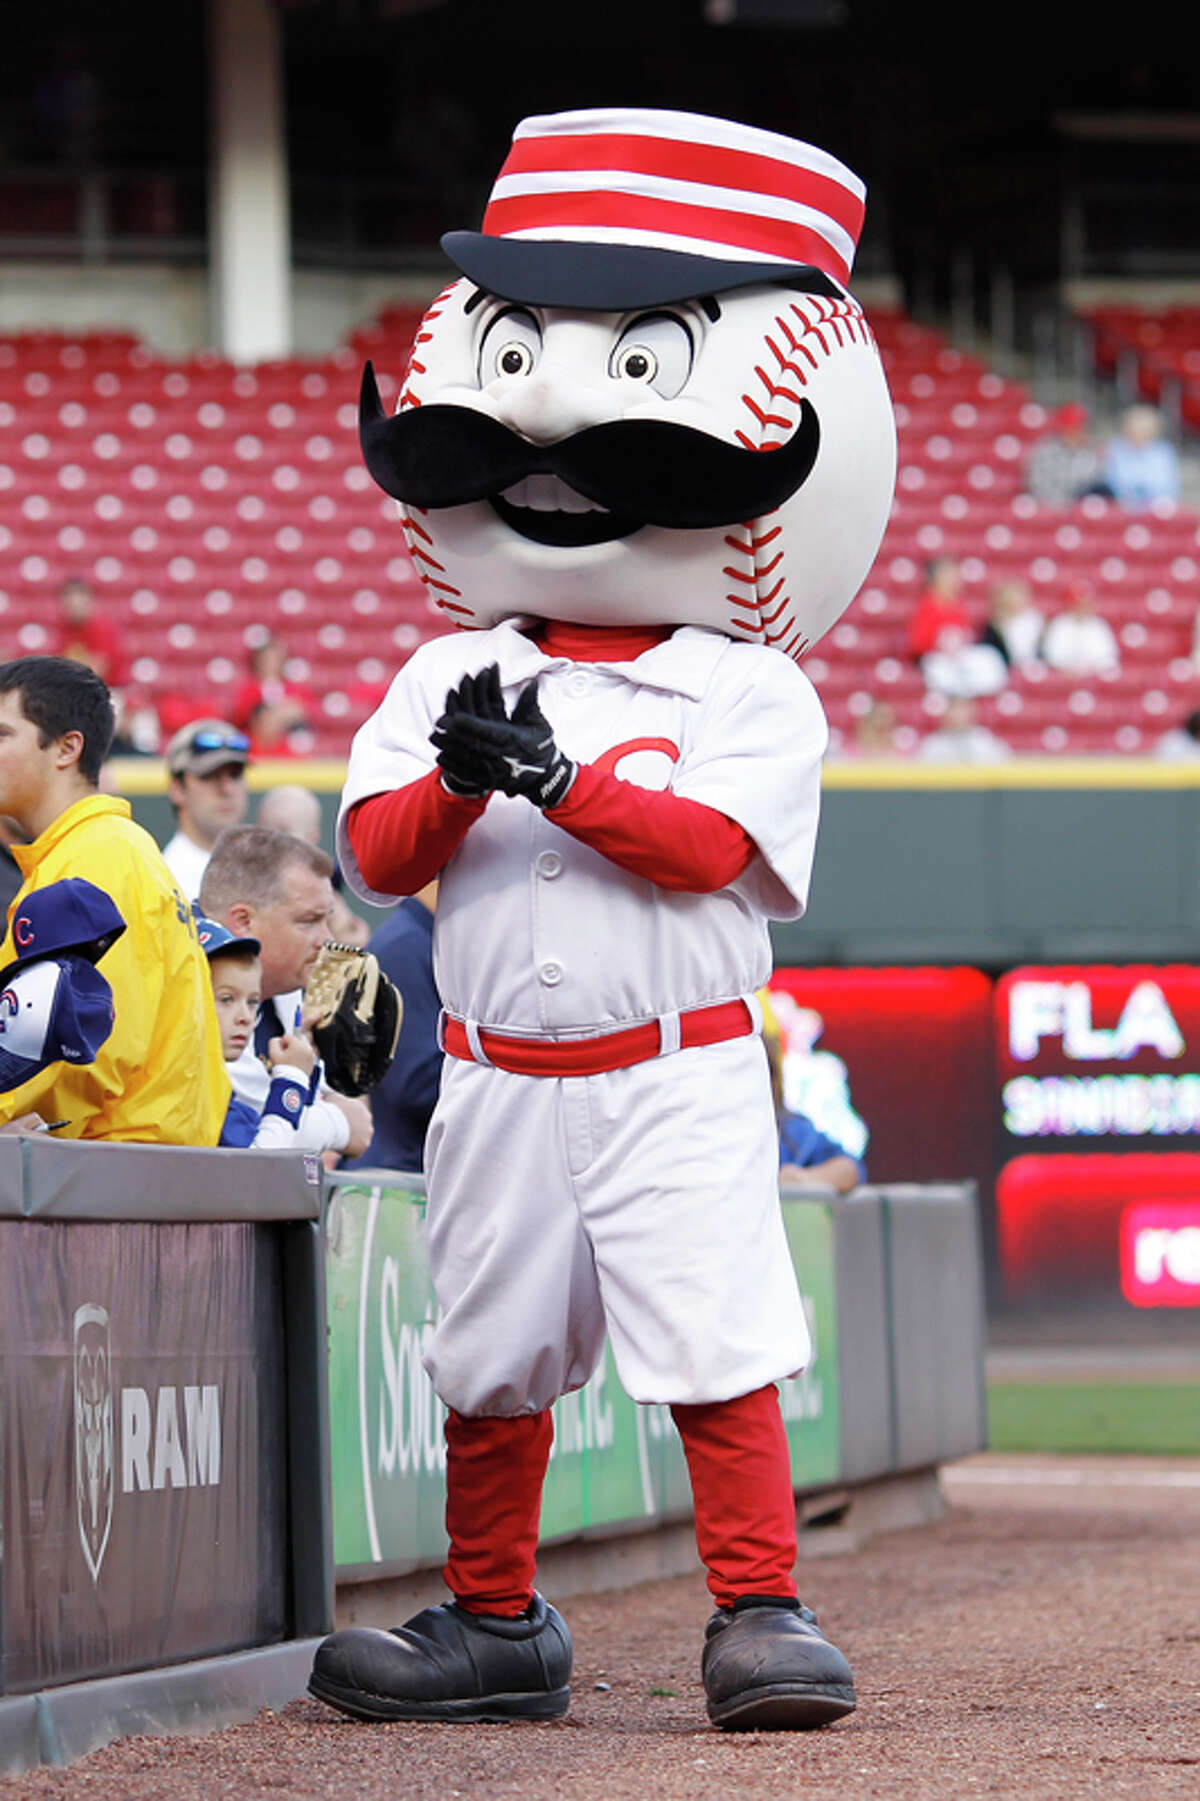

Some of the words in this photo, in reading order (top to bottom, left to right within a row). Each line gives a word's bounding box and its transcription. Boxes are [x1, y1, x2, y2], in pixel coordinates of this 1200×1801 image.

[15, 917, 35, 947] C
[1009, 979, 1186, 1061] FLA
[121, 1384, 221, 1493] RAM
